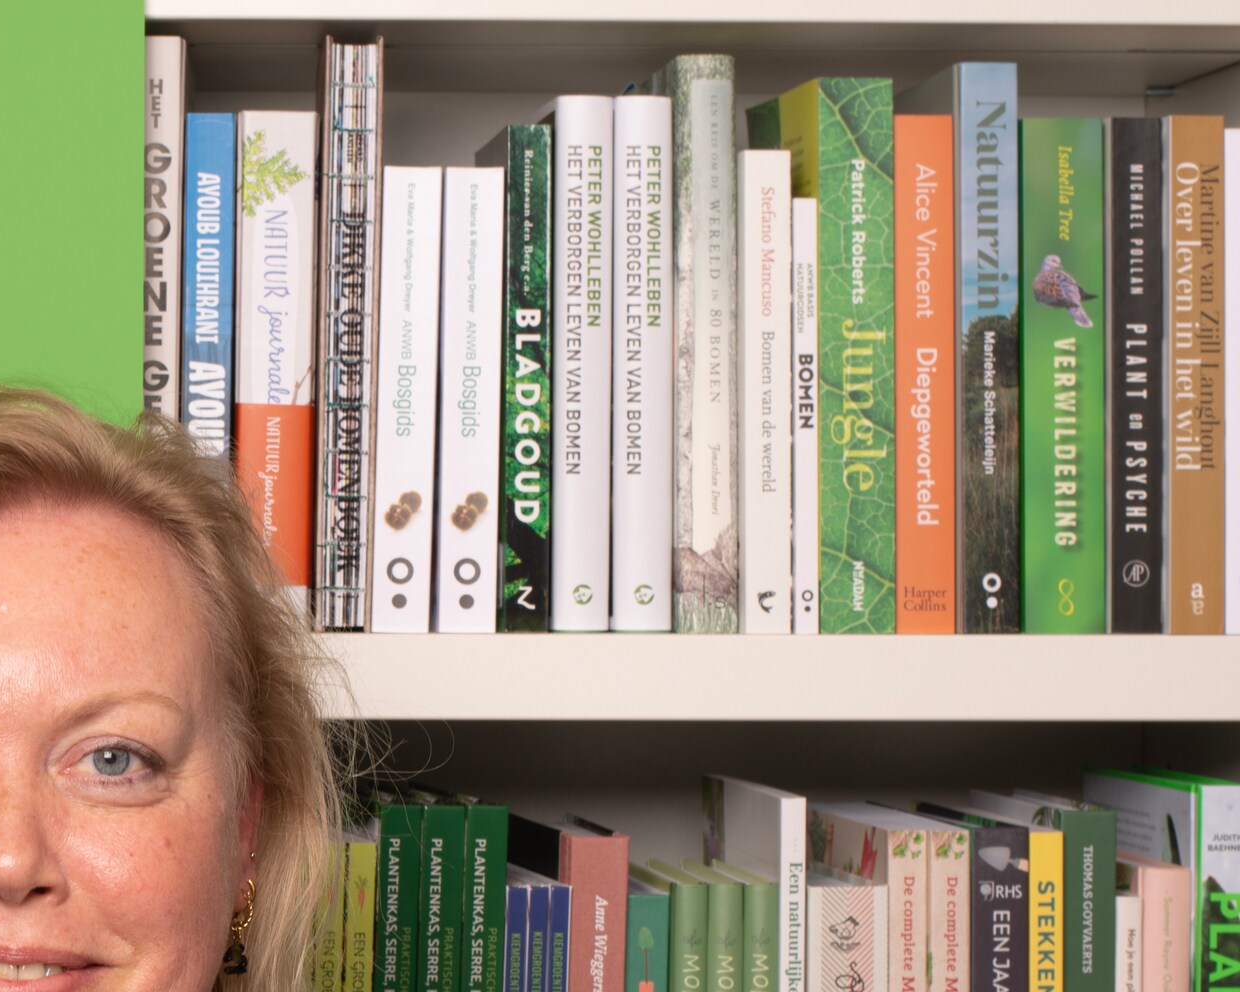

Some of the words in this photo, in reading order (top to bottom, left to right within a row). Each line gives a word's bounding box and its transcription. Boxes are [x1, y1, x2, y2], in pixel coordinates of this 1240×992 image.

[567, 145, 581, 181] HET
[587, 145, 601, 205] PETER
[851, 160, 866, 224] Patrick
[916, 164, 935, 221] Alice
[1058, 146, 1072, 203] Isabella
[196, 172, 220, 234] AYOUB
[761, 187, 774, 244] Stefano
[976, 101, 1007, 309] Natuurzin
[1059, 209, 1072, 241] Tree
[1129, 164, 1143, 229] MICHAEL
[1176, 162, 1199, 232] Over
[1200, 164, 1219, 256] Martine
[143, 143, 172, 346] GROENE
[264, 209, 289, 297] NATUUR
[336, 213, 365, 298] DIKKE
[566, 186, 581, 296] VERBORGEN
[587, 210, 600, 327] WOHLLEBEN
[851, 231, 866, 304] Roberts
[1130, 239, 1143, 295] POLLAN
[195, 239, 219, 343] LOUIHRANI
[761, 249, 774, 317] Mancuso
[916, 229, 936, 318] Vincent
[1176, 241, 1200, 315] leven
[1200, 261, 1214, 303] van
[337, 309, 364, 386] OUDE
[402, 320, 413, 359] ANWB
[566, 303, 581, 362] LEVEN
[762, 331, 774, 384] Bomen
[984, 331, 996, 386] Marieke
[1125, 324, 1147, 399] PLANT
[1176, 321, 1199, 350] in
[1195, 311, 1220, 354] Zijll
[393, 365, 417, 437] Bosgids
[566, 366, 581, 404] VAN
[762, 390, 771, 415] van
[798, 354, 814, 429] BOMEN
[831, 319, 887, 490] Jungle
[1176, 358, 1200, 400] het
[514, 309, 541, 524] BLADGOUD
[566, 410, 580, 474] BOMEN
[762, 420, 775, 437] de
[911, 348, 938, 525] Diepgeworteld
[982, 392, 996, 475] Schatteleijn
[1053, 338, 1076, 546] VERWILDERING
[1129, 414, 1145, 429] en
[1176, 409, 1201, 471] wild
[1195, 363, 1220, 471] Langhout
[334, 397, 362, 572] BOMENBOEK
[762, 442, 775, 493] wereld
[1125, 441, 1146, 533] PSYCHE
[470, 839, 487, 936] PLANTENKAS,
[788, 862, 802, 893] Een
[903, 876, 914, 896] De
[1082, 846, 1093, 896] THOMAS
[594, 896, 608, 930] Anne
[899, 900, 913, 970] complete
[991, 911, 1009, 953] EEN
[1082, 901, 1093, 973] GOYVAERTS
[468, 939, 483, 986] SERRE,
[485, 928, 497, 992] PRAKTISCH
